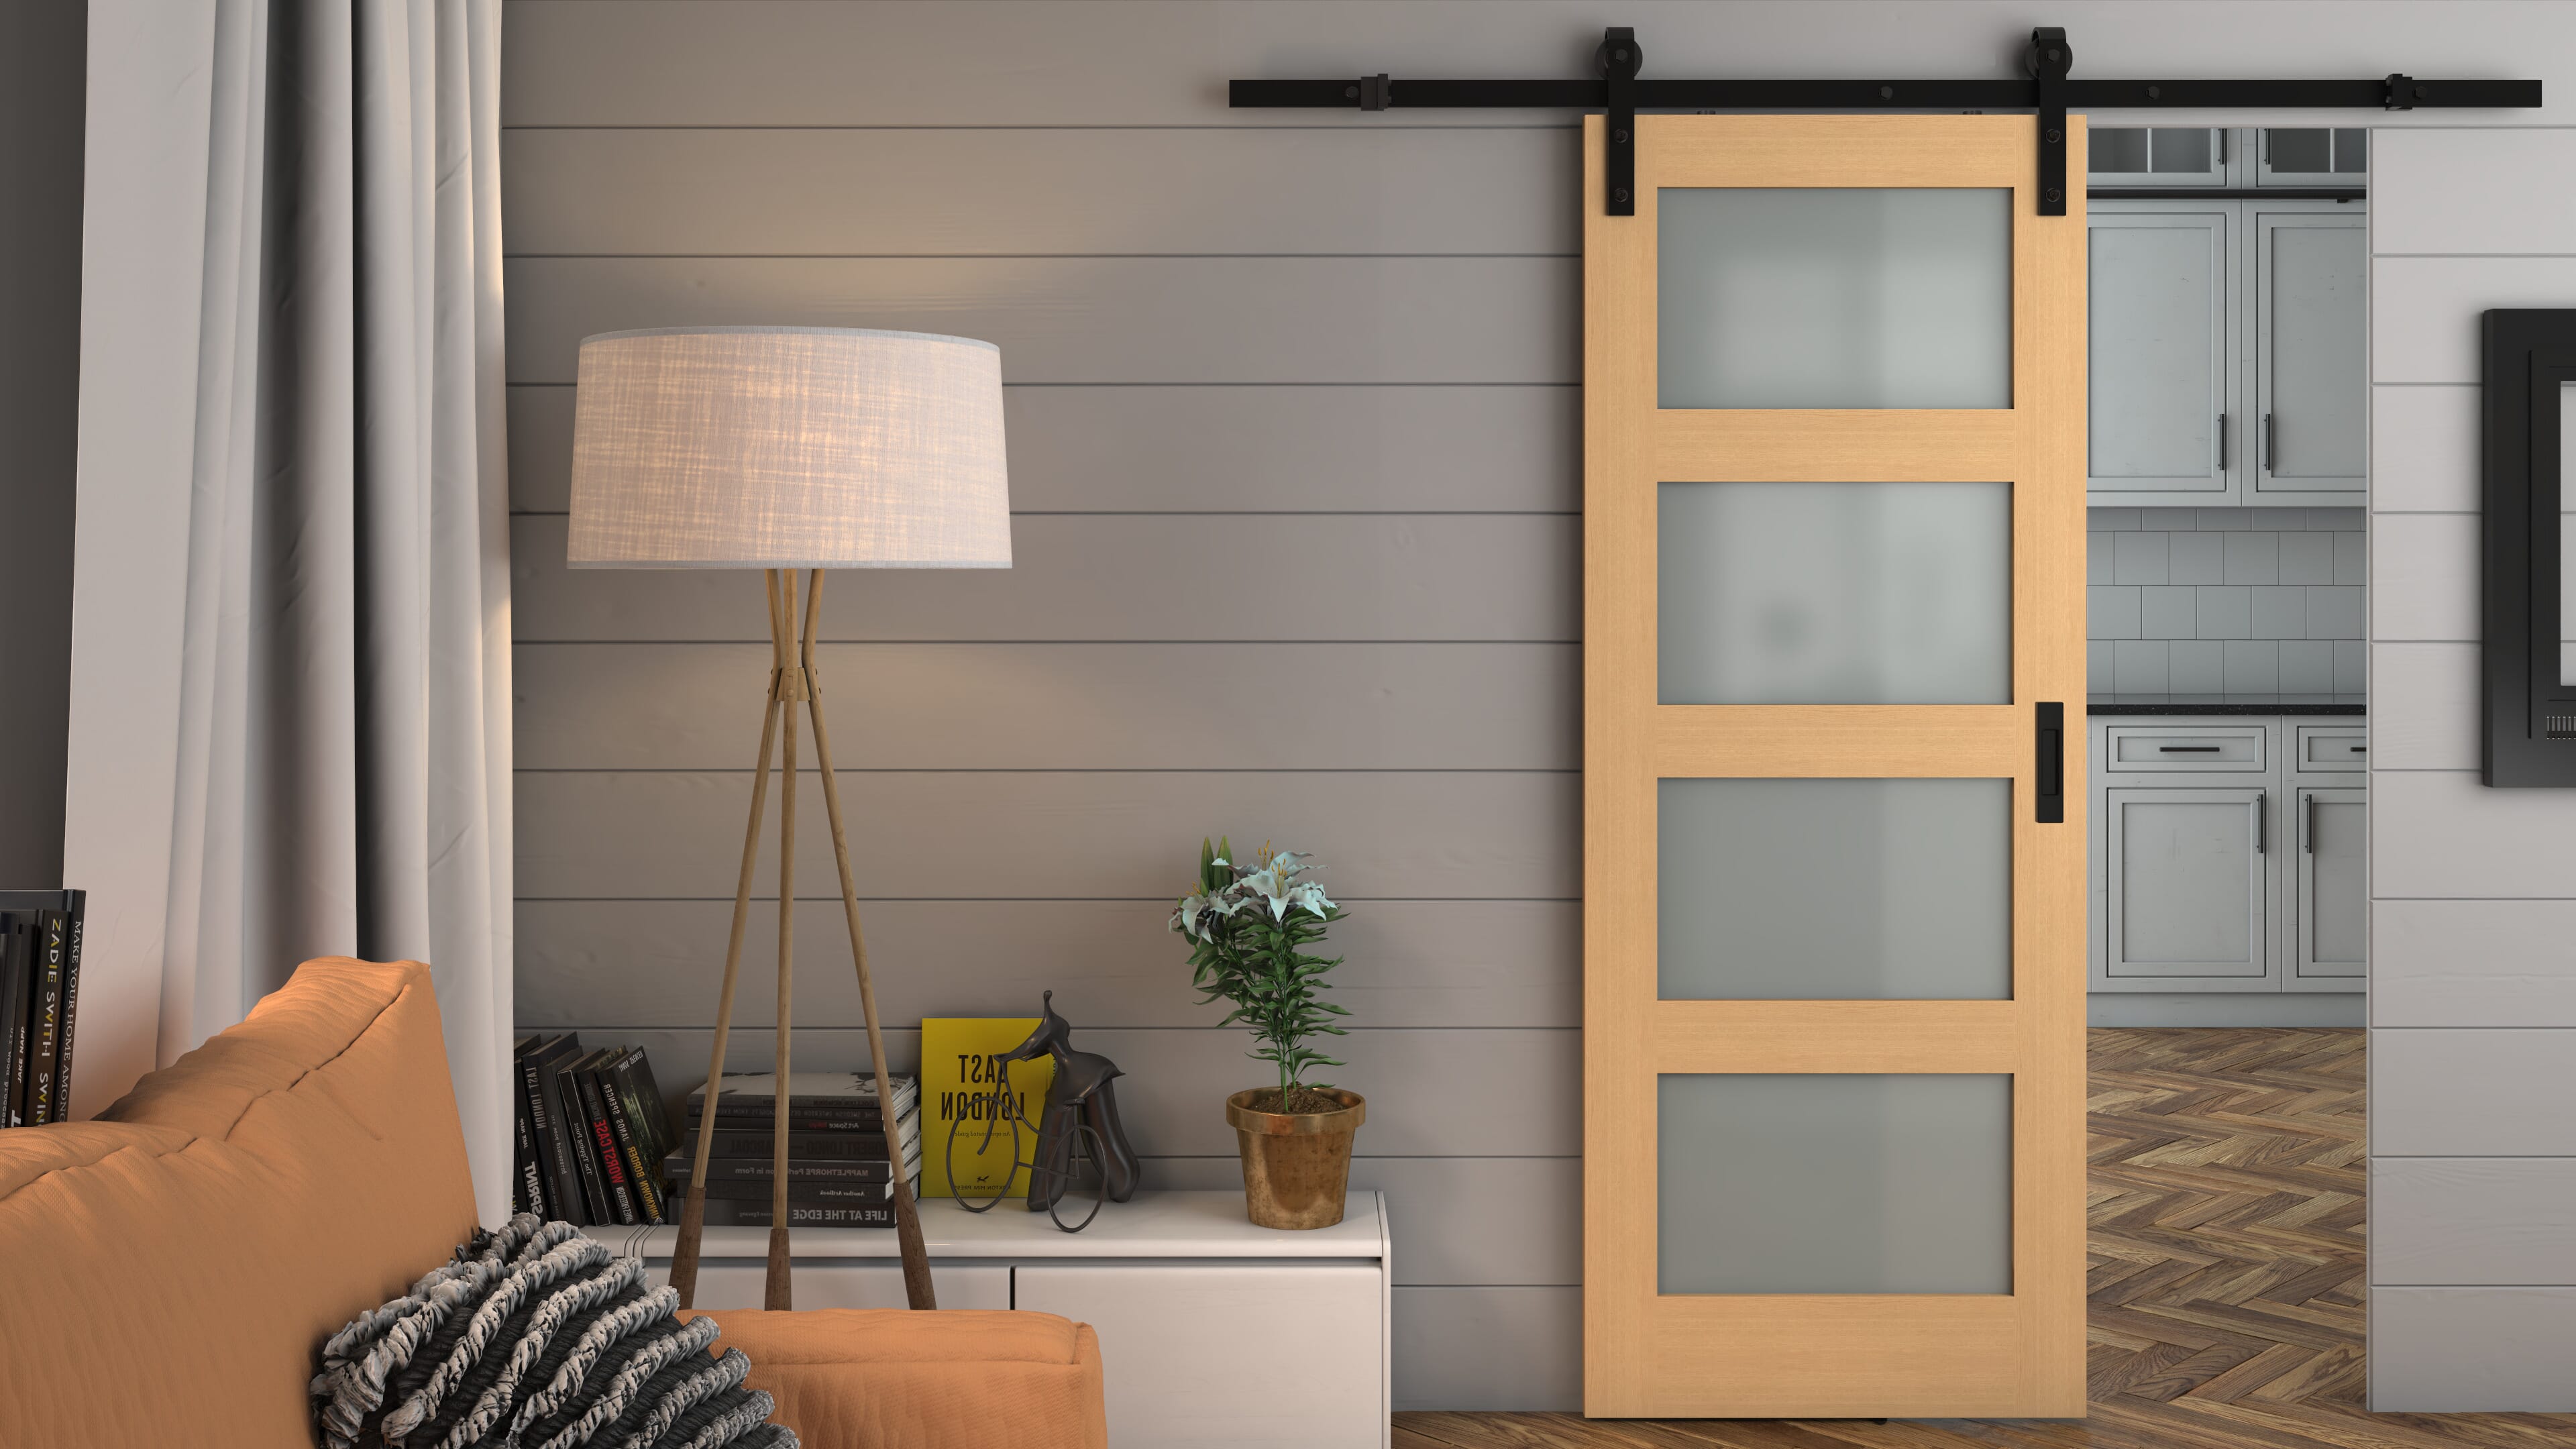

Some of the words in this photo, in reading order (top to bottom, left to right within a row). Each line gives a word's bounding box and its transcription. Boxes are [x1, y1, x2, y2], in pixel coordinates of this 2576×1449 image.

[48, 918, 61, 983] ZADIE
[72, 920, 81, 963] MAKE
[68, 967, 77, 1010] YOUR
[64, 1014, 74, 1061] HOME
[36, 1073, 48, 1126] SWIN
